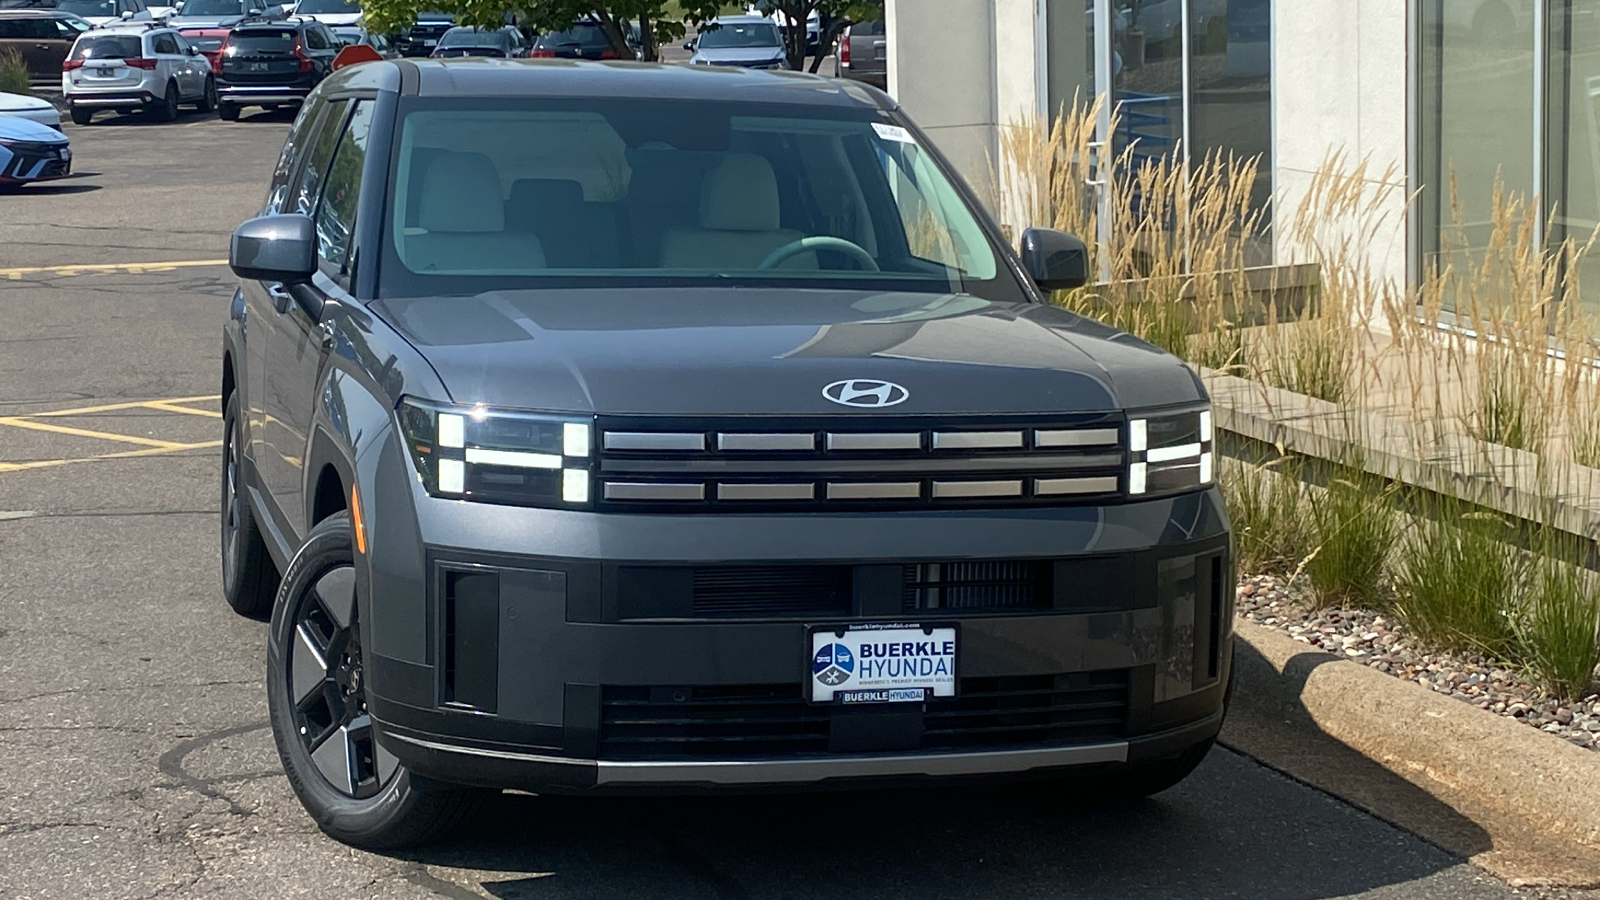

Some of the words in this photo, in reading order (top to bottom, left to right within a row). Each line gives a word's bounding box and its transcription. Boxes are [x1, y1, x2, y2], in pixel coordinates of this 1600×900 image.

[860, 641, 954, 658] BUERKLE
[859, 657, 954, 678] HYUNDAI
[844, 691, 889, 702] BUERKLE
[890, 690, 923, 701] HYUNDAI
